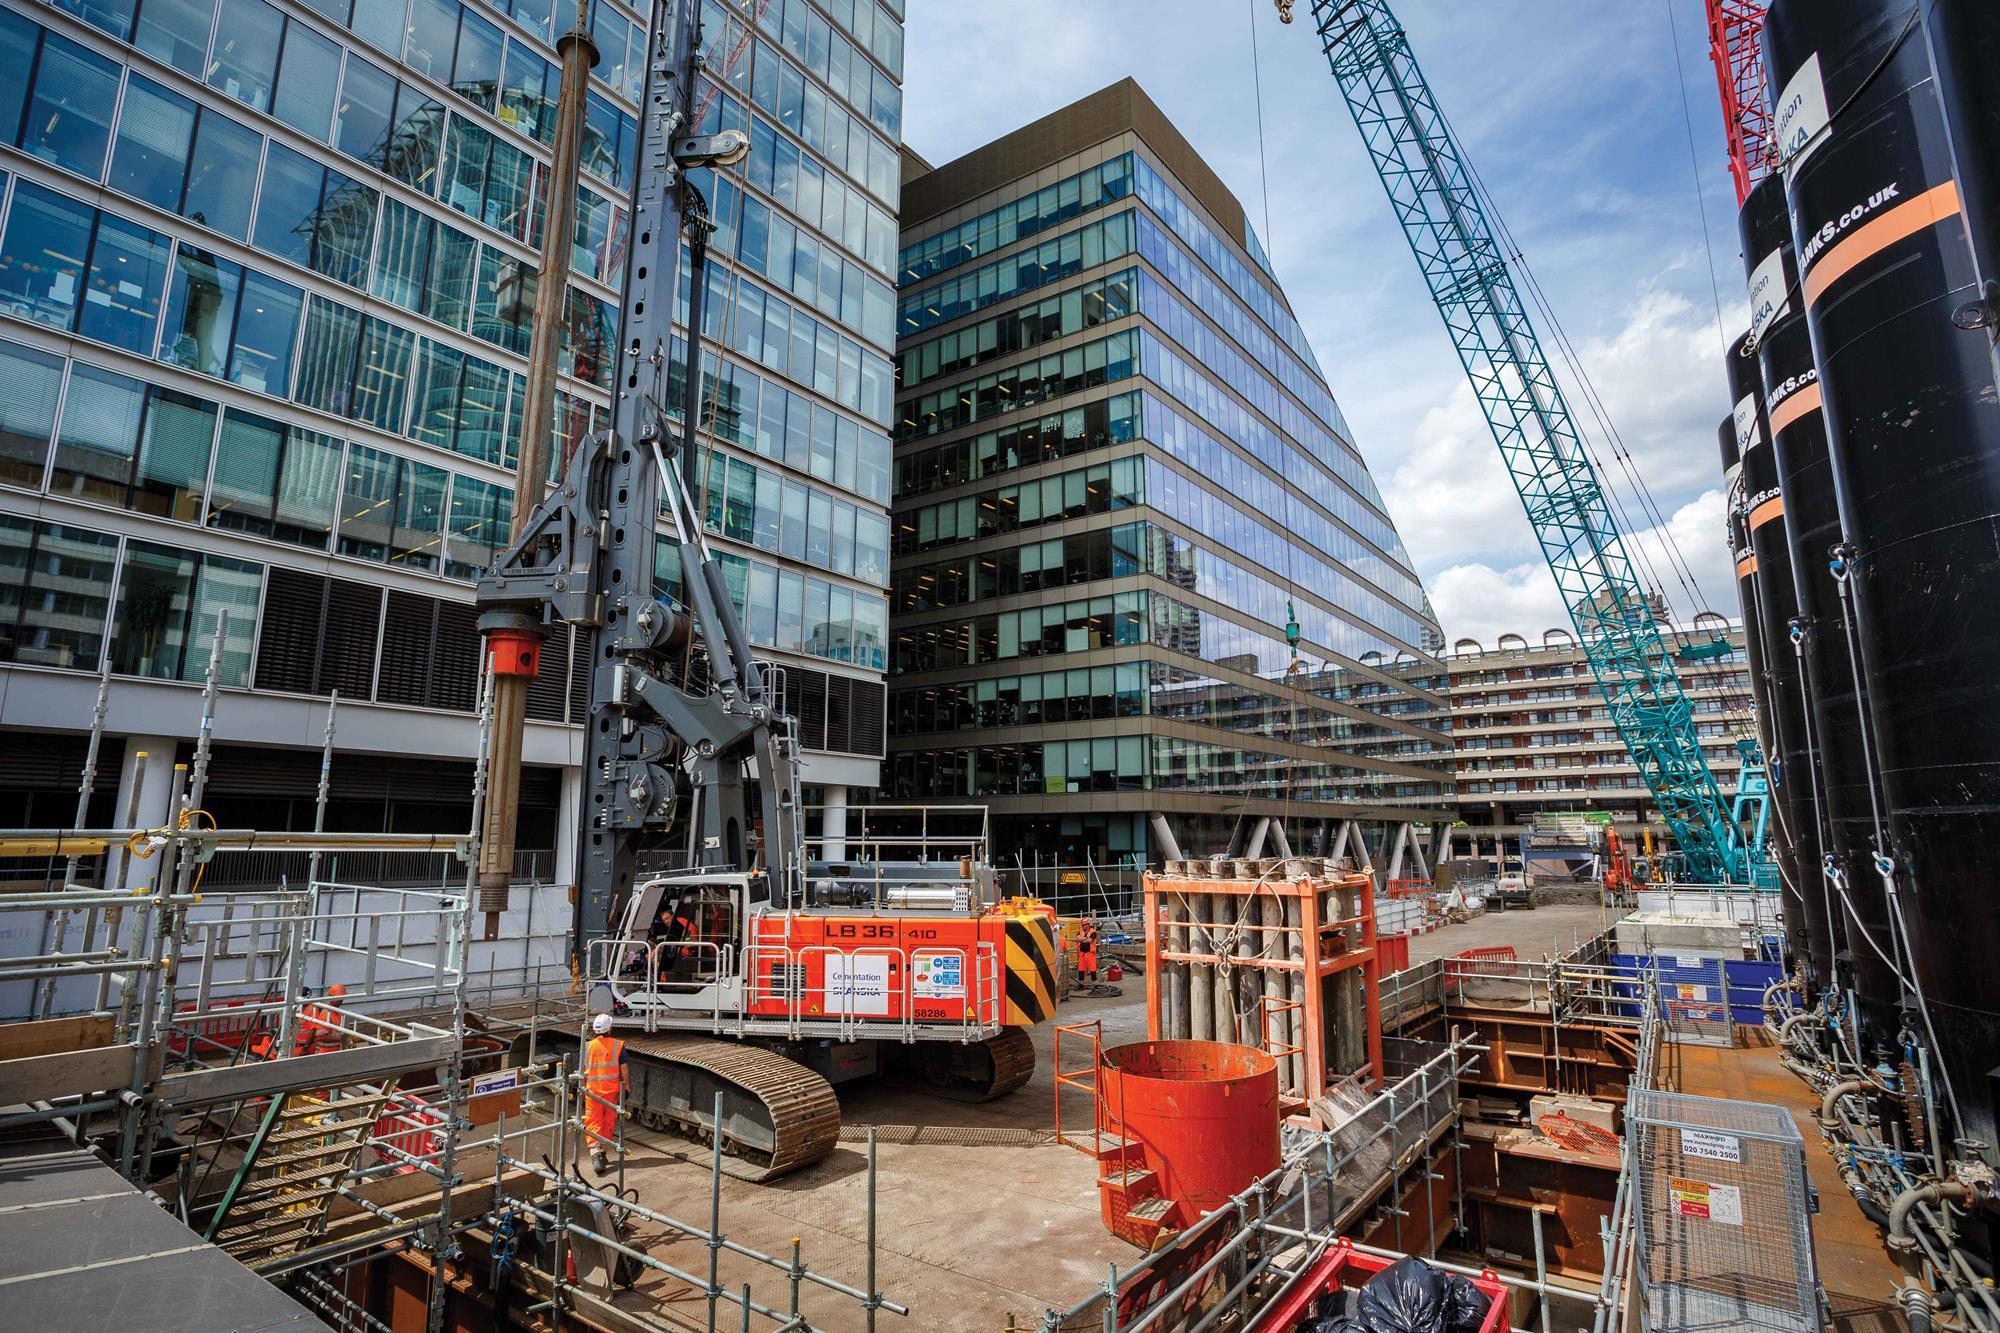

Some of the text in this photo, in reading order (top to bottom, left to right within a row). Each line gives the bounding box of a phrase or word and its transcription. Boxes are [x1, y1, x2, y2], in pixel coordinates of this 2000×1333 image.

[826, 924, 894, 938] LB 36
[908, 929, 937, 939] 410
[914, 1009, 946, 1018] 58286
[1684, 1145, 1738, 1160] 020 7540 2500
